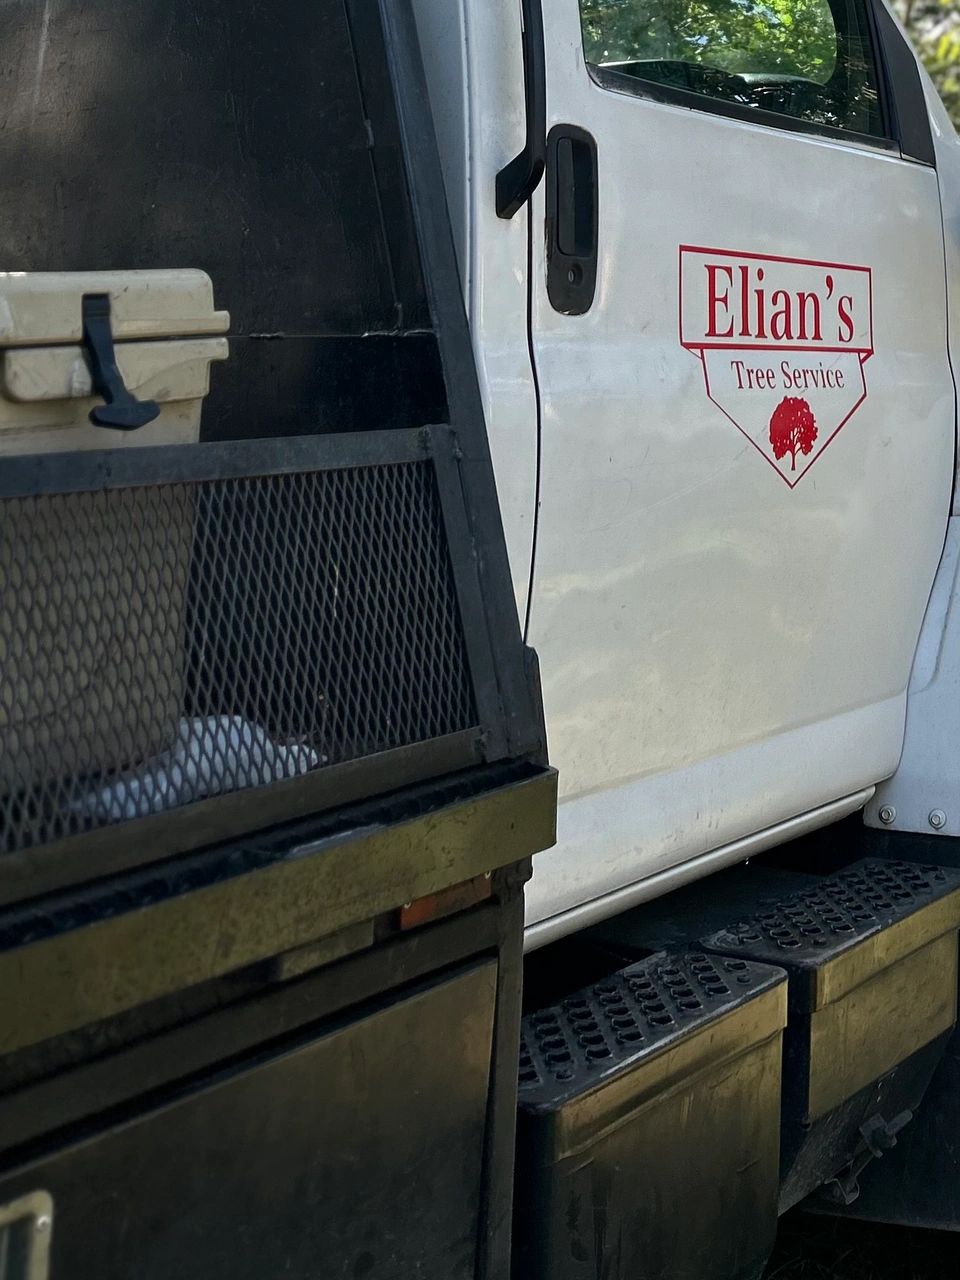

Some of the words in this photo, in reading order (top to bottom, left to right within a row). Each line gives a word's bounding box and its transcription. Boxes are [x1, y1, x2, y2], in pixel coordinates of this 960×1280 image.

[704, 264, 854, 343] Elian's
[731, 360, 776, 389] Tree
[780, 361, 844, 389] Service
